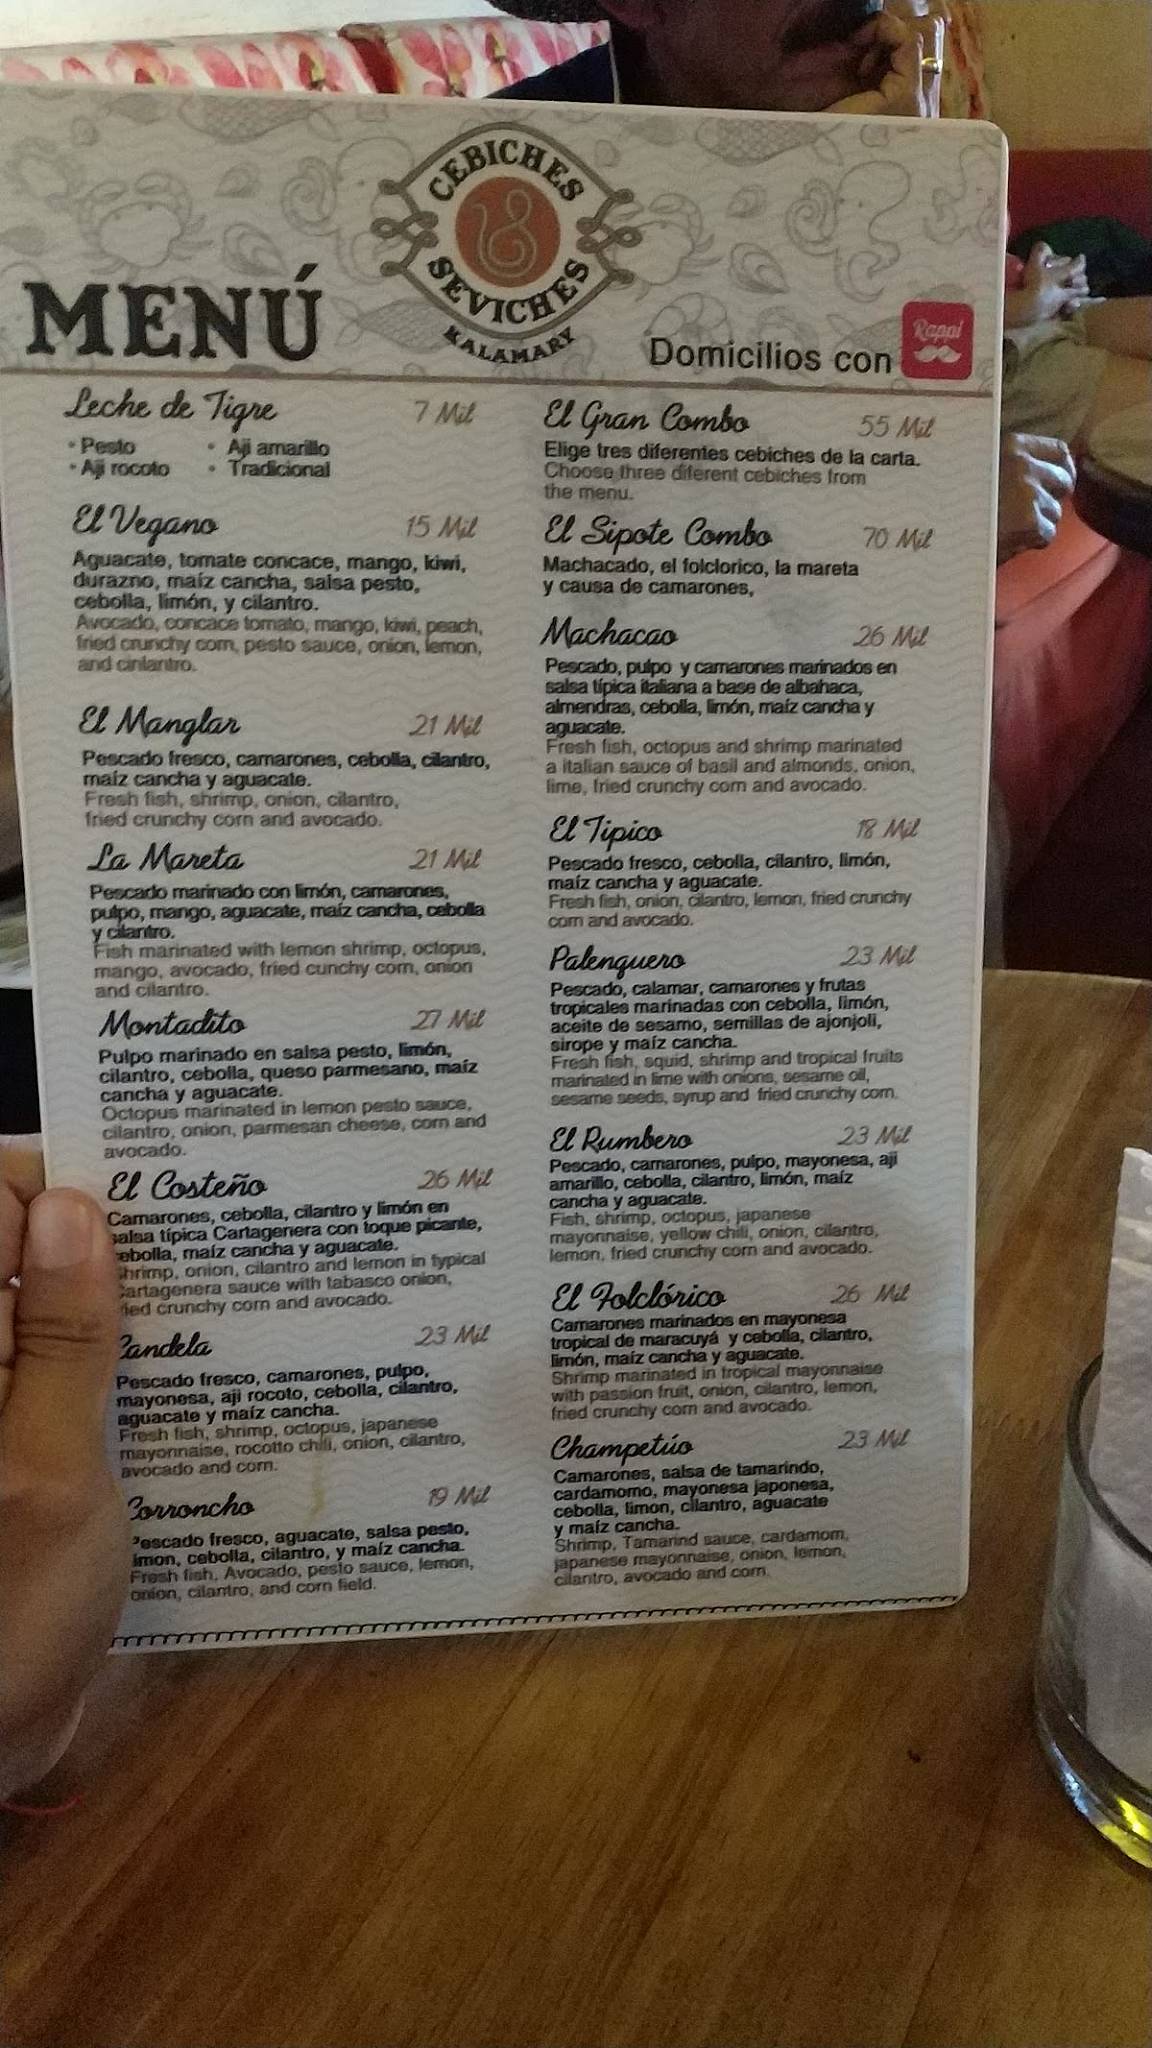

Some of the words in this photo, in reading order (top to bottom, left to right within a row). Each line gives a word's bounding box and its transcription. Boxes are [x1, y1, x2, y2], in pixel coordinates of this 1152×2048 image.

[427, 139, 584, 201] CEBICHES
[427, 256, 589, 324] SEVICHES
[23, 263, 323, 361] MENÚ
[443, 326, 576, 364] KALAMARY
[650, 337, 823, 372] Domicilios
[834, 347, 891, 374] con
[63, 386, 151, 419] Leche
[160, 389, 194, 419] de
[203, 389, 278, 432] Tigre
[415, 401, 427, 423] 7
[435, 401, 477, 425] Mil
[544, 400, 574, 428] El
[581, 399, 649, 440] Gran
[661, 402, 749, 433] Combo
[857, 415, 889, 437] 55
[896, 416, 936, 438] Mil
[81, 438, 135, 454] Pesto
[257, 438, 330, 456] amarillo
[545, 442, 590, 463] Elige
[598, 443, 631, 459] tres
[638, 444, 728, 462] diferentes
[735, 446, 815, 464] cebiches
[821, 448, 843, 464] de
[849, 448, 864, 465] la
[870, 449, 920, 466] carta.
[111, 461, 169, 477] rocoto
[229, 460, 330, 478] Tradicional
[72, 504, 102, 533] El
[110, 503, 219, 547] Vegano
[405, 514, 430, 537] 15
[437, 515, 478, 539] Mil
[544, 514, 576, 543] El
[581, 514, 674, 554] Sipote
[683, 517, 773, 548] Combo
[863, 526, 887, 549] 70
[896, 527, 935, 550] Mil
[73, 551, 171, 572] Aguacate,
[180, 552, 246, 569] tomate
[253, 557, 340, 572] concace,
[347, 558, 417, 574] mango,
[424, 554, 466, 573] kiwi,
[543, 555, 654, 575] Machacado,
[661, 557, 676, 573] el
[775, 558, 791, 575] la
[797, 559, 859, 576] mareta
[544, 581, 552, 597] y
[560, 581, 613, 594] causa
[621, 578, 642, 594] de
[649, 582, 754, 598] camarones,
[539, 616, 679, 647] Machacao
[853, 625, 884, 647] 26
[891, 625, 929, 649] Mil
[78, 705, 107, 734] El
[115, 705, 242, 747] Manglar
[408, 714, 436, 737] 21
[443, 713, 484, 738] Mil
[547, 737, 595, 753] Fresh
[603, 737, 636, 756] fish,
[643, 737, 710, 757] octopus
[717, 737, 749, 753] and
[754, 737, 811, 757] shrimp
[817, 736, 902, 753] marinated
[83, 770, 127, 786] maíz
[135, 770, 200, 786] cancha
[207, 774, 216, 790] y
[223, 770, 310, 790] aguacate.
[86, 810, 127, 826] fried
[133, 810, 206, 830] crunchy
[260, 810, 294, 826] and
[301, 810, 381, 826] avocado.
[856, 819, 874, 839] 18
[883, 817, 921, 840] Mil
[548, 815, 575, 842] El
[582, 815, 663, 852] Tipico
[87, 842, 131, 871] La
[138, 842, 245, 873] Mareta
[409, 849, 437, 870] 21
[443, 848, 483, 872] Mil
[548, 854, 623, 871] Pescado
[630, 853, 687, 872] fresco,
[693, 852, 759, 872] cebolla,
[766, 852, 833, 871] cilantro,
[840, 851, 890, 870] limón,
[94, 942, 132, 958] Fish
[140, 941, 232, 958] marinated
[238, 941, 274, 957] with
[280, 940, 335, 957] lemon
[412, 939, 486, 960] octopus,
[839, 945, 873, 967] 23
[878, 944, 917, 967] Mil
[98, 1008, 247, 1039] Montadito
[410, 1009, 441, 1030] 27
[446, 1008, 487, 1031] Mil
[551, 1016, 602, 1032] aceite
[609, 1015, 629, 1032] de
[636, 1018, 706, 1034] sesamo,
[714, 1013, 783, 1030] semillas
[789, 1013, 810, 1029] de
[99, 1046, 153, 1068] Pulpo
[160, 1045, 247, 1062] marinado
[254, 1048, 276, 1060] en
[283, 1043, 330, 1060] salsa
[337, 1042, 392, 1063] pesto,
[399, 1040, 452, 1060] limón,
[549, 1126, 575, 1152] El
[580, 1124, 694, 1153] Rumbero
[836, 1126, 869, 1146] 23
[874, 1124, 914, 1147] Mil
[107, 1170, 141, 1202] El
[150, 1169, 268, 1200] Costeño
[417, 1169, 449, 1190] 26
[455, 1167, 495, 1190] Mil
[107, 1205, 215, 1228] Camarones,
[221, 1203, 288, 1224] cebolla,
[294, 1200, 357, 1218] cilantro
[362, 1203, 371, 1220] y
[377, 1197, 423, 1215] limón
[428, 1200, 449, 1213] en
[551, 1282, 581, 1312] El
[590, 1279, 727, 1310] Folclórico
[830, 1284, 860, 1304] 26
[873, 1282, 911, 1303] Mil
[551, 1313, 644, 1331] Camarones
[650, 1310, 734, 1328] marinados
[739, 1314, 759, 1326] en
[764, 1311, 846, 1330] mayonesa
[414, 1325, 446, 1347] 23
[454, 1324, 491, 1346] Mil
[118, 1405, 200, 1428] aguacate
[207, 1408, 216, 1424] y
[222, 1403, 264, 1420] maíz
[271, 1400, 339, 1418] cancha.
[550, 1433, 694, 1466] Champetúo
[837, 1430, 869, 1450] 23
[873, 1427, 912, 1448] Mil
[428, 1487, 449, 1507] 19
[455, 1484, 493, 1506] Mil
[554, 1481, 657, 1503] cardamomo,
[664, 1481, 748, 1500] mayonesa
[755, 1474, 834, 1497] japonesa,
